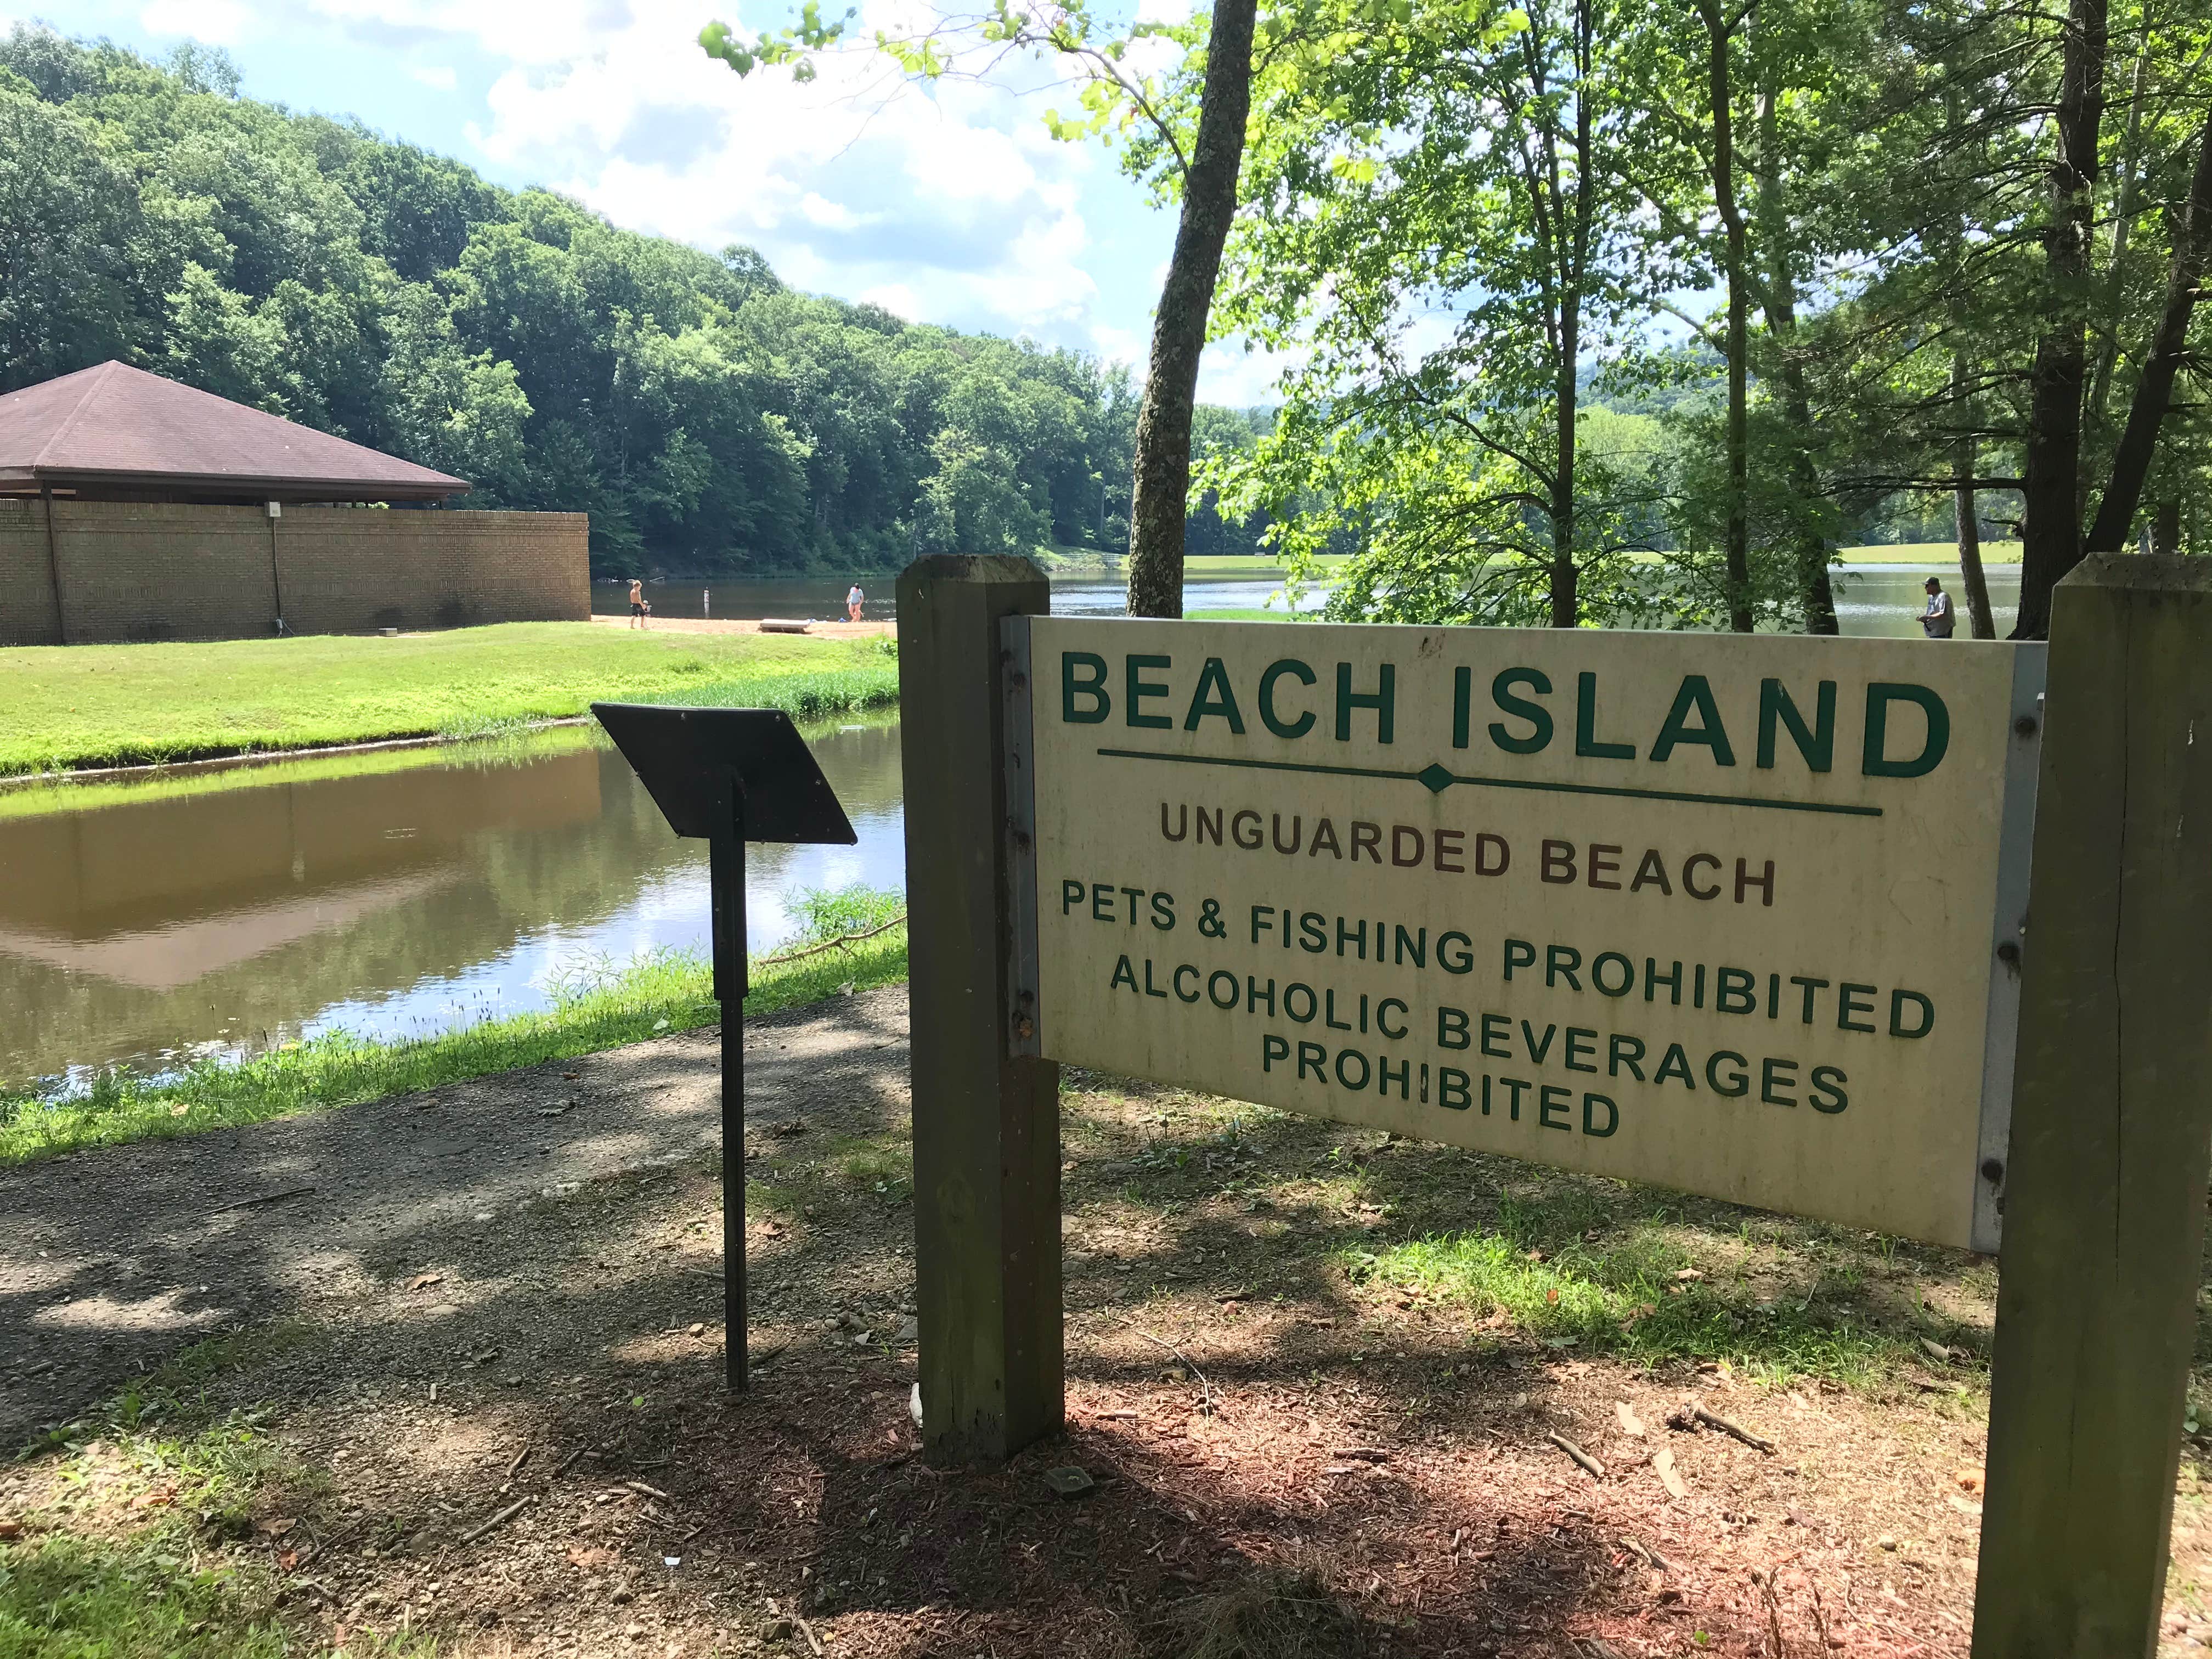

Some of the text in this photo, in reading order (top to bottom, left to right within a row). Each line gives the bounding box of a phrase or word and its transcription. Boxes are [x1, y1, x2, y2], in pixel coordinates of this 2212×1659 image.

[1062, 651, 1950, 779] BEACH ISLAND
[1161, 803, 1775, 907] UNGUARDED BEACH
[1063, 879, 1935, 1039] PETS & FISHING PROHIBITED
[1110, 955, 1848, 1114] ALCOHOLIC BEVERAGES
[1263, 1034, 1620, 1137] PROHIBITED
